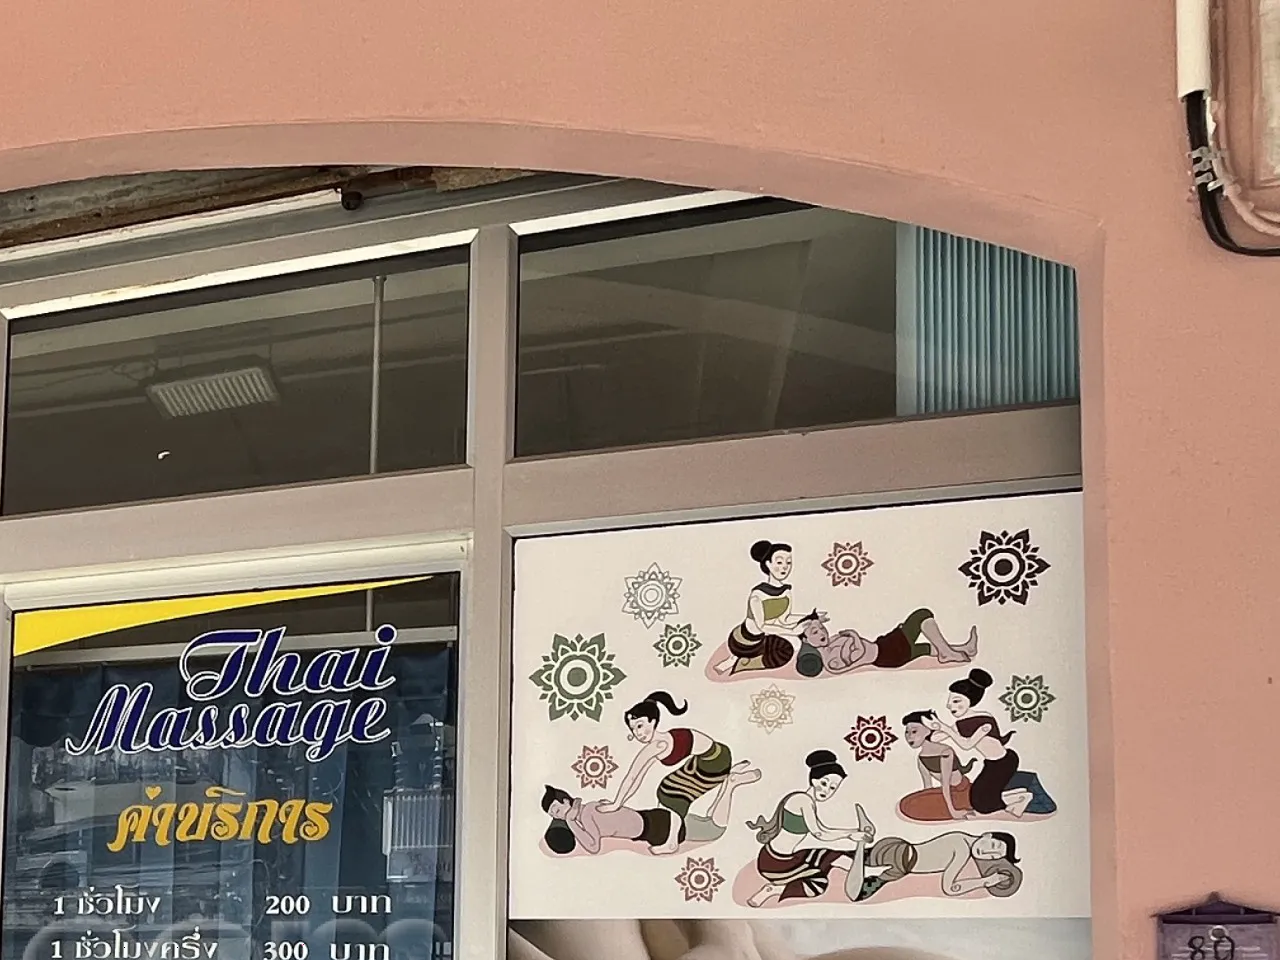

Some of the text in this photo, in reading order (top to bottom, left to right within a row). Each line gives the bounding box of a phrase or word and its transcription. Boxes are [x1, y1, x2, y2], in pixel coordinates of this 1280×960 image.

[179, 623, 397, 701] Thai
[65, 682, 392, 762] Massage
[106, 786, 333, 852] ค่าบริการ
[53, 884, 392, 915] 1 ชั่วโมง 200 บาท
[50, 940, 63, 959] 1
